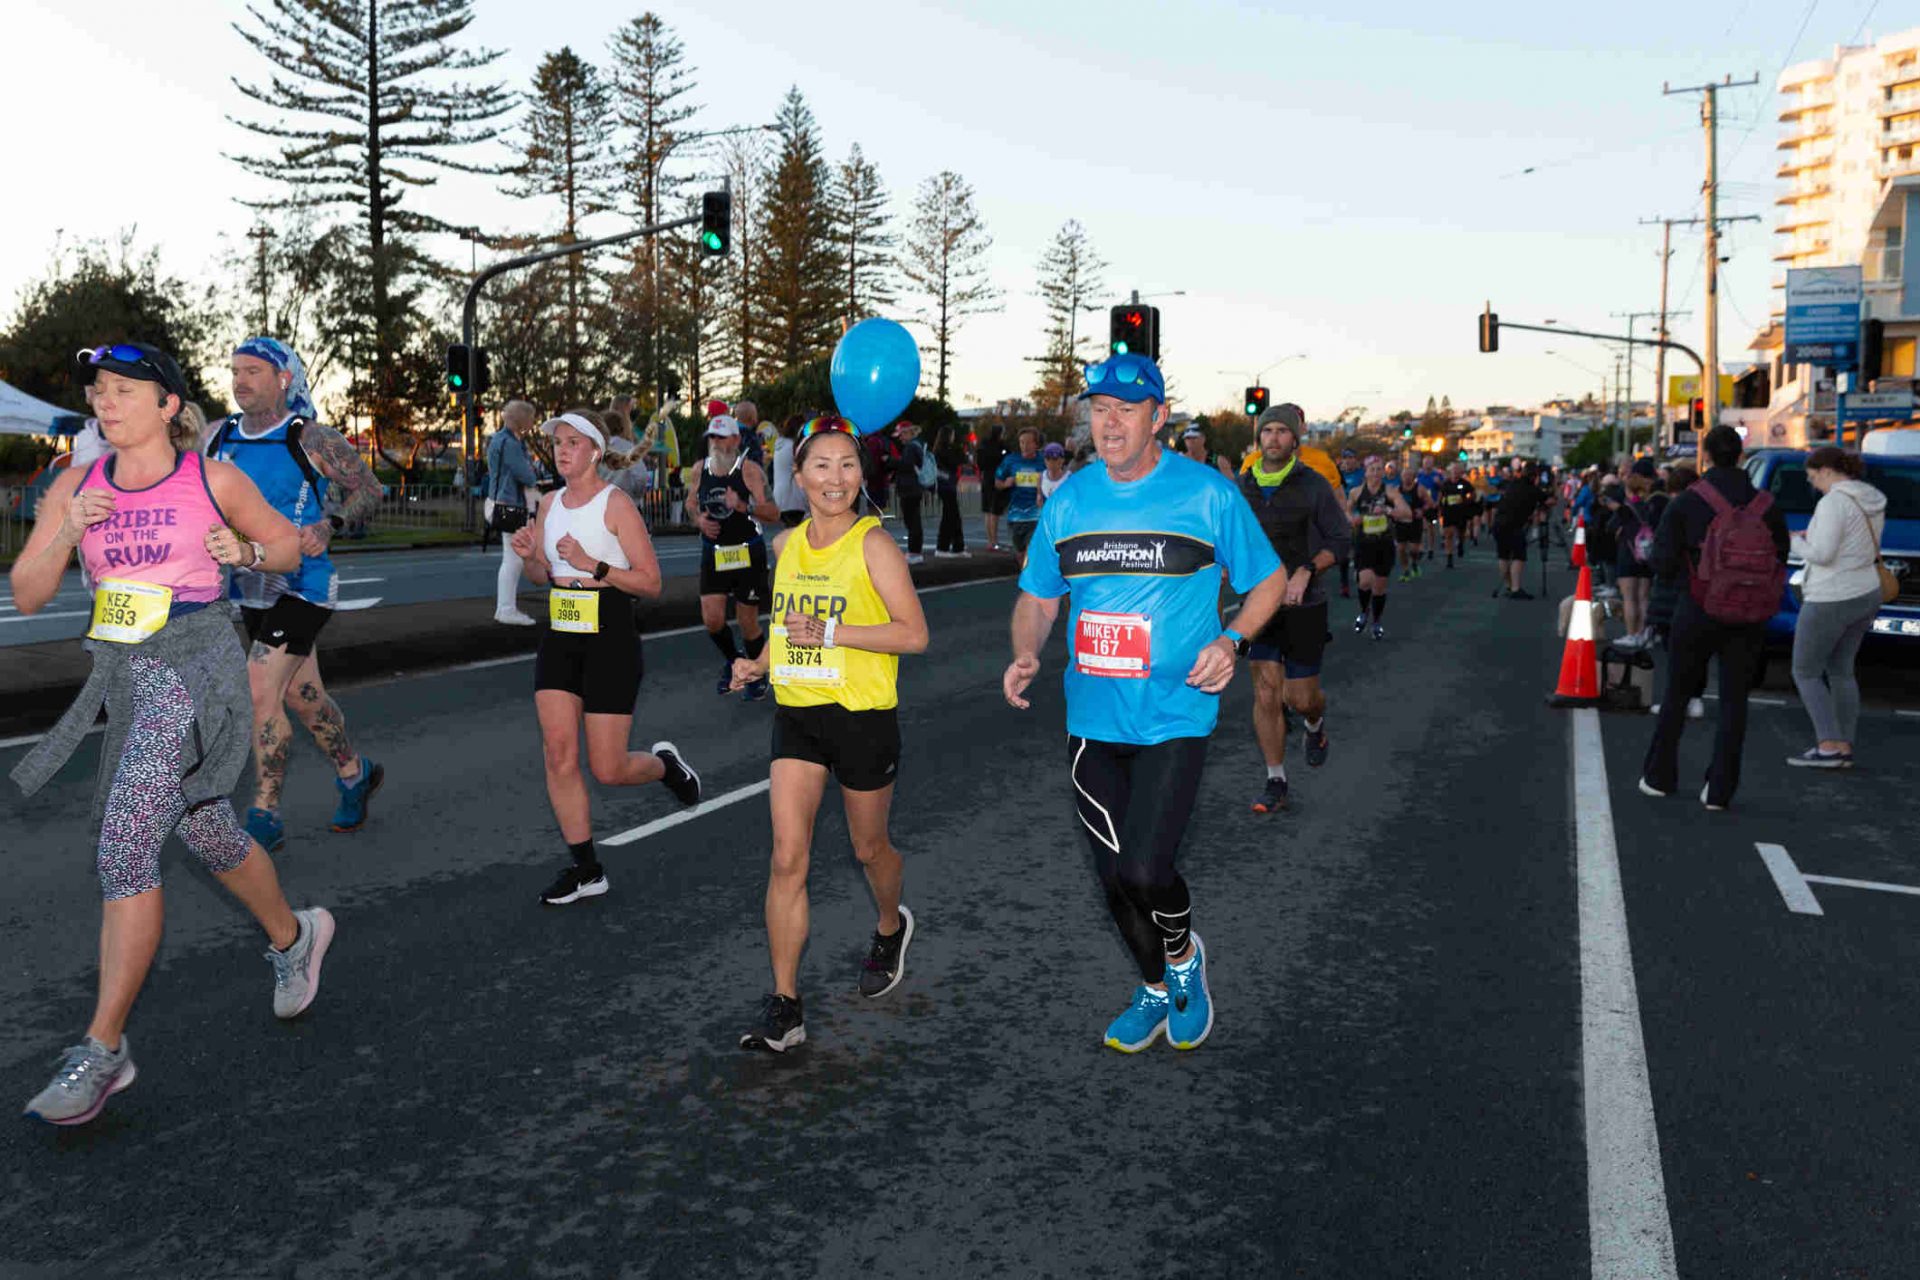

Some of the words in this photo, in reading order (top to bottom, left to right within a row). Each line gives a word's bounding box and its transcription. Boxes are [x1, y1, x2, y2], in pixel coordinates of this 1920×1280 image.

[105, 531, 124, 544] ON
[131, 529, 159, 541] THE
[1103, 541, 1139, 550] Brisbane
[1076, 549, 1154, 563] MARATHON
[1121, 560, 1153, 568] Festival
[107, 592, 132, 608] KEZ
[561, 599, 575, 609] RIN
[101, 607, 137, 626] 2593
[557, 608, 581, 621] 3989
[1083, 621, 1121, 640] MIKEY
[1125, 626, 1135, 641] T
[1092, 637, 1120, 656] 167
[787, 650, 823, 666] 3874
